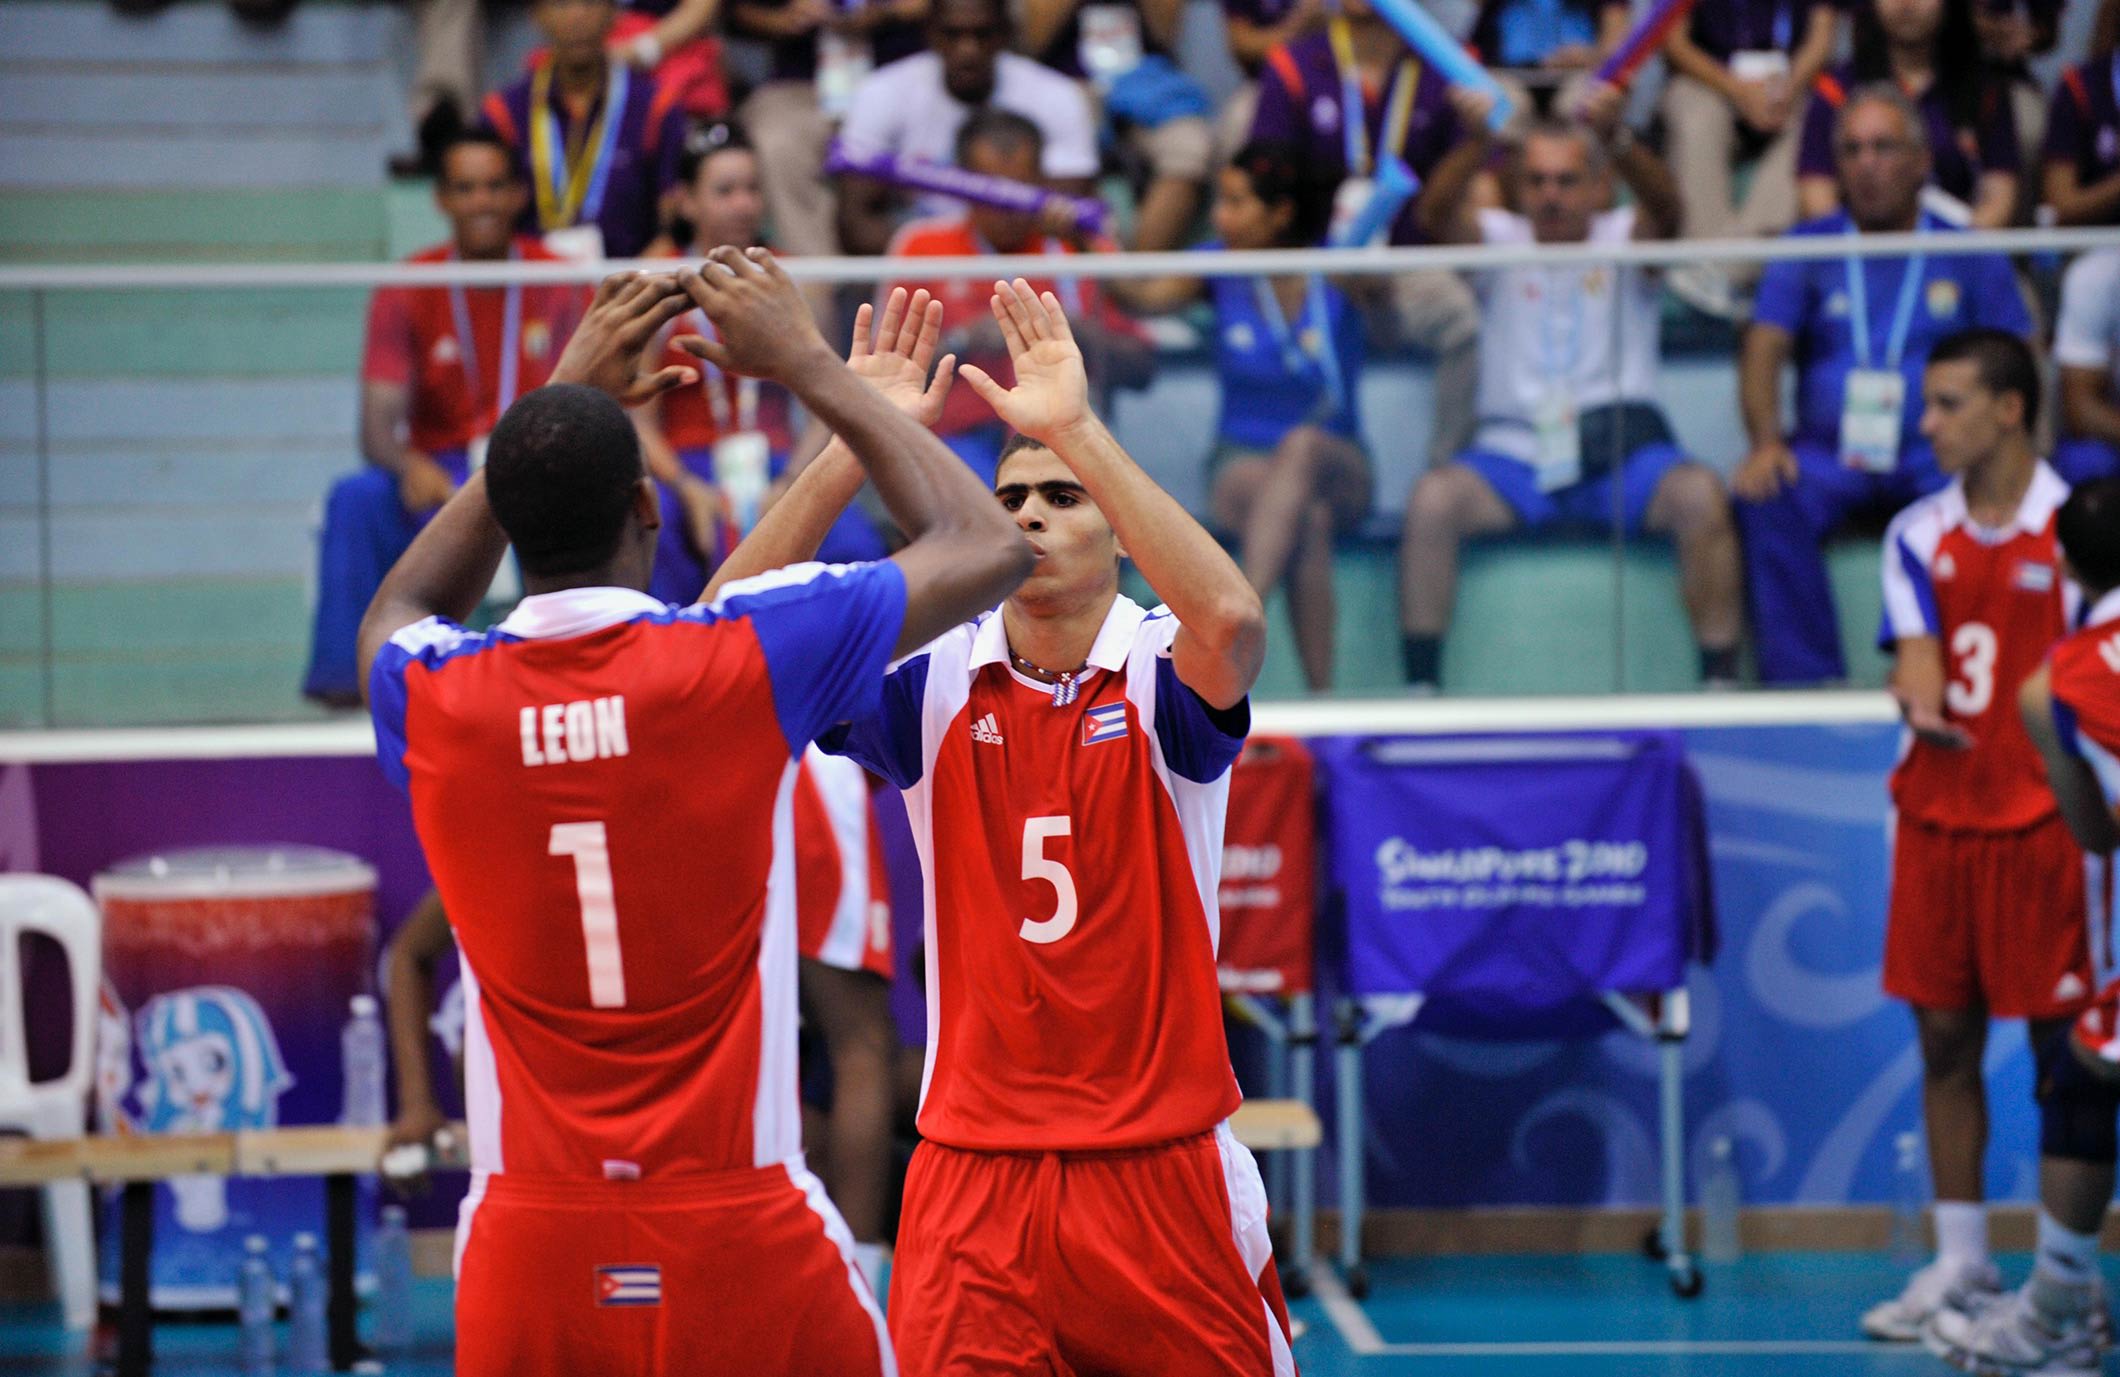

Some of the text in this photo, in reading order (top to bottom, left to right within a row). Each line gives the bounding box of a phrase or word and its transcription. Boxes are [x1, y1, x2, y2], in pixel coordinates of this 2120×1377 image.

[1947, 621, 1998, 717] 3
[520, 695, 629, 767] LEON
[548, 820, 627, 1008] 1
[1018, 815, 1078, 944] 5
